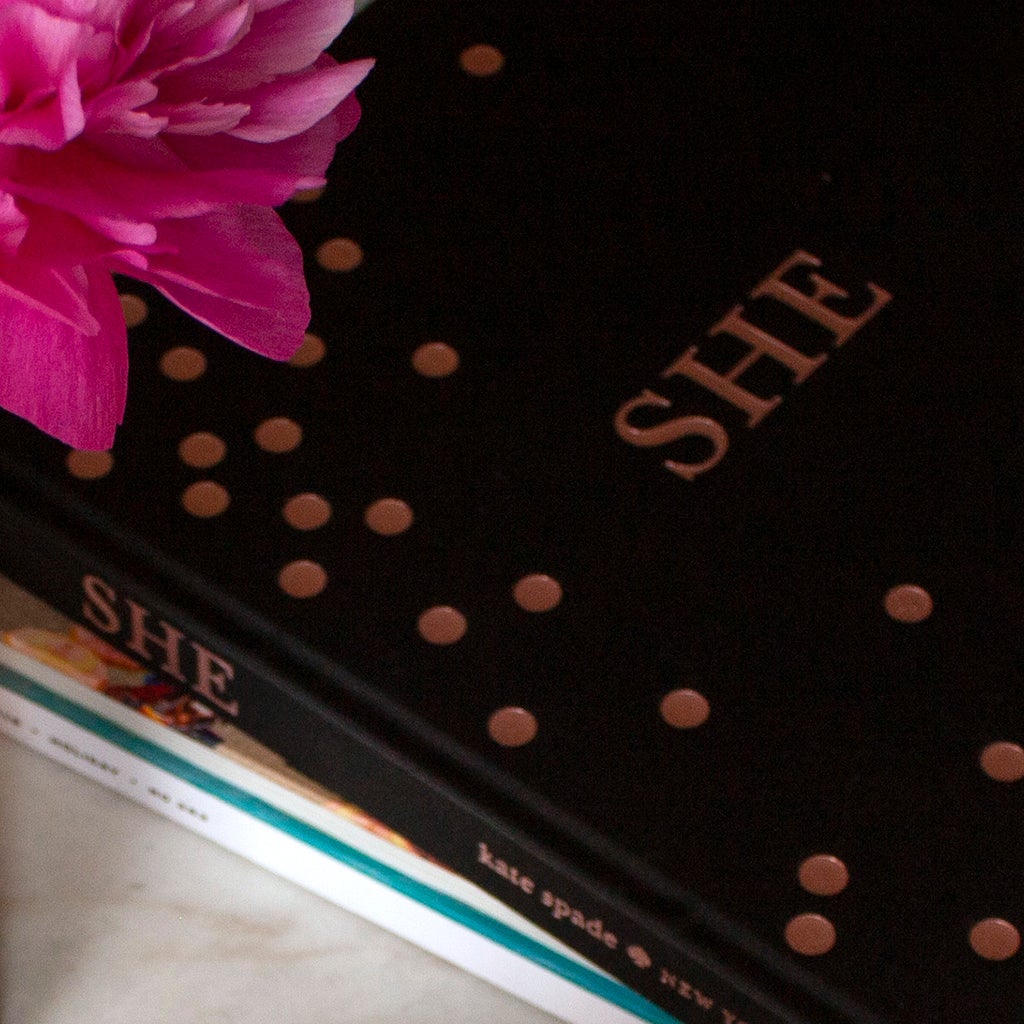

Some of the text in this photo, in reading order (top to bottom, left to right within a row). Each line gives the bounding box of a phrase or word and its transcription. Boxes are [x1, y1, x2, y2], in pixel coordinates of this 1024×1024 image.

[614, 249, 893, 481] SHE
[81, 575, 239, 716] SHE
[478, 842, 618, 949] kate spade
[660, 968, 714, 1009] NEW
